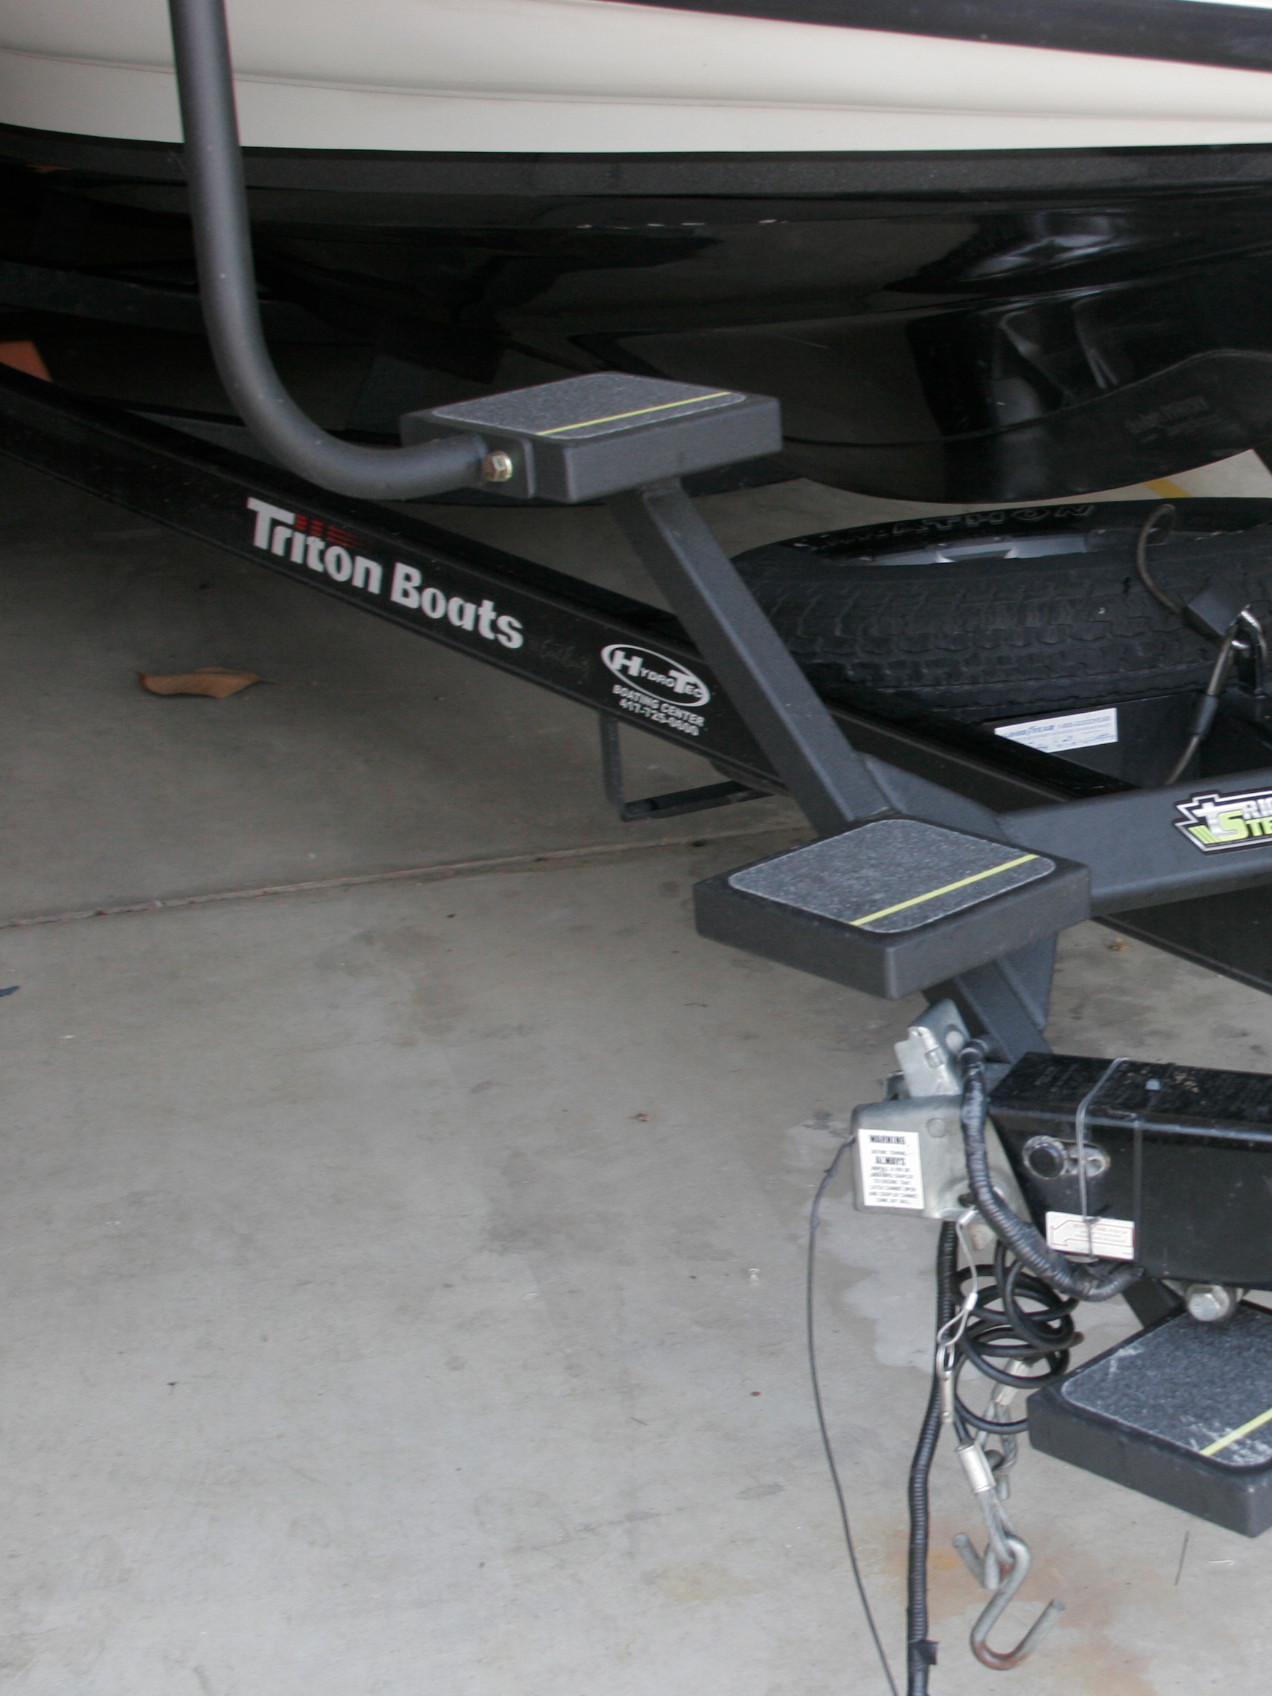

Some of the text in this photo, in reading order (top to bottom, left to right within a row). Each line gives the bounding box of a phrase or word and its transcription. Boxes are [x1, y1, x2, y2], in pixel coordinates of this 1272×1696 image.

[246, 497, 524, 649] Triton Boats
[612, 684, 705, 727] BOATING CENTER
